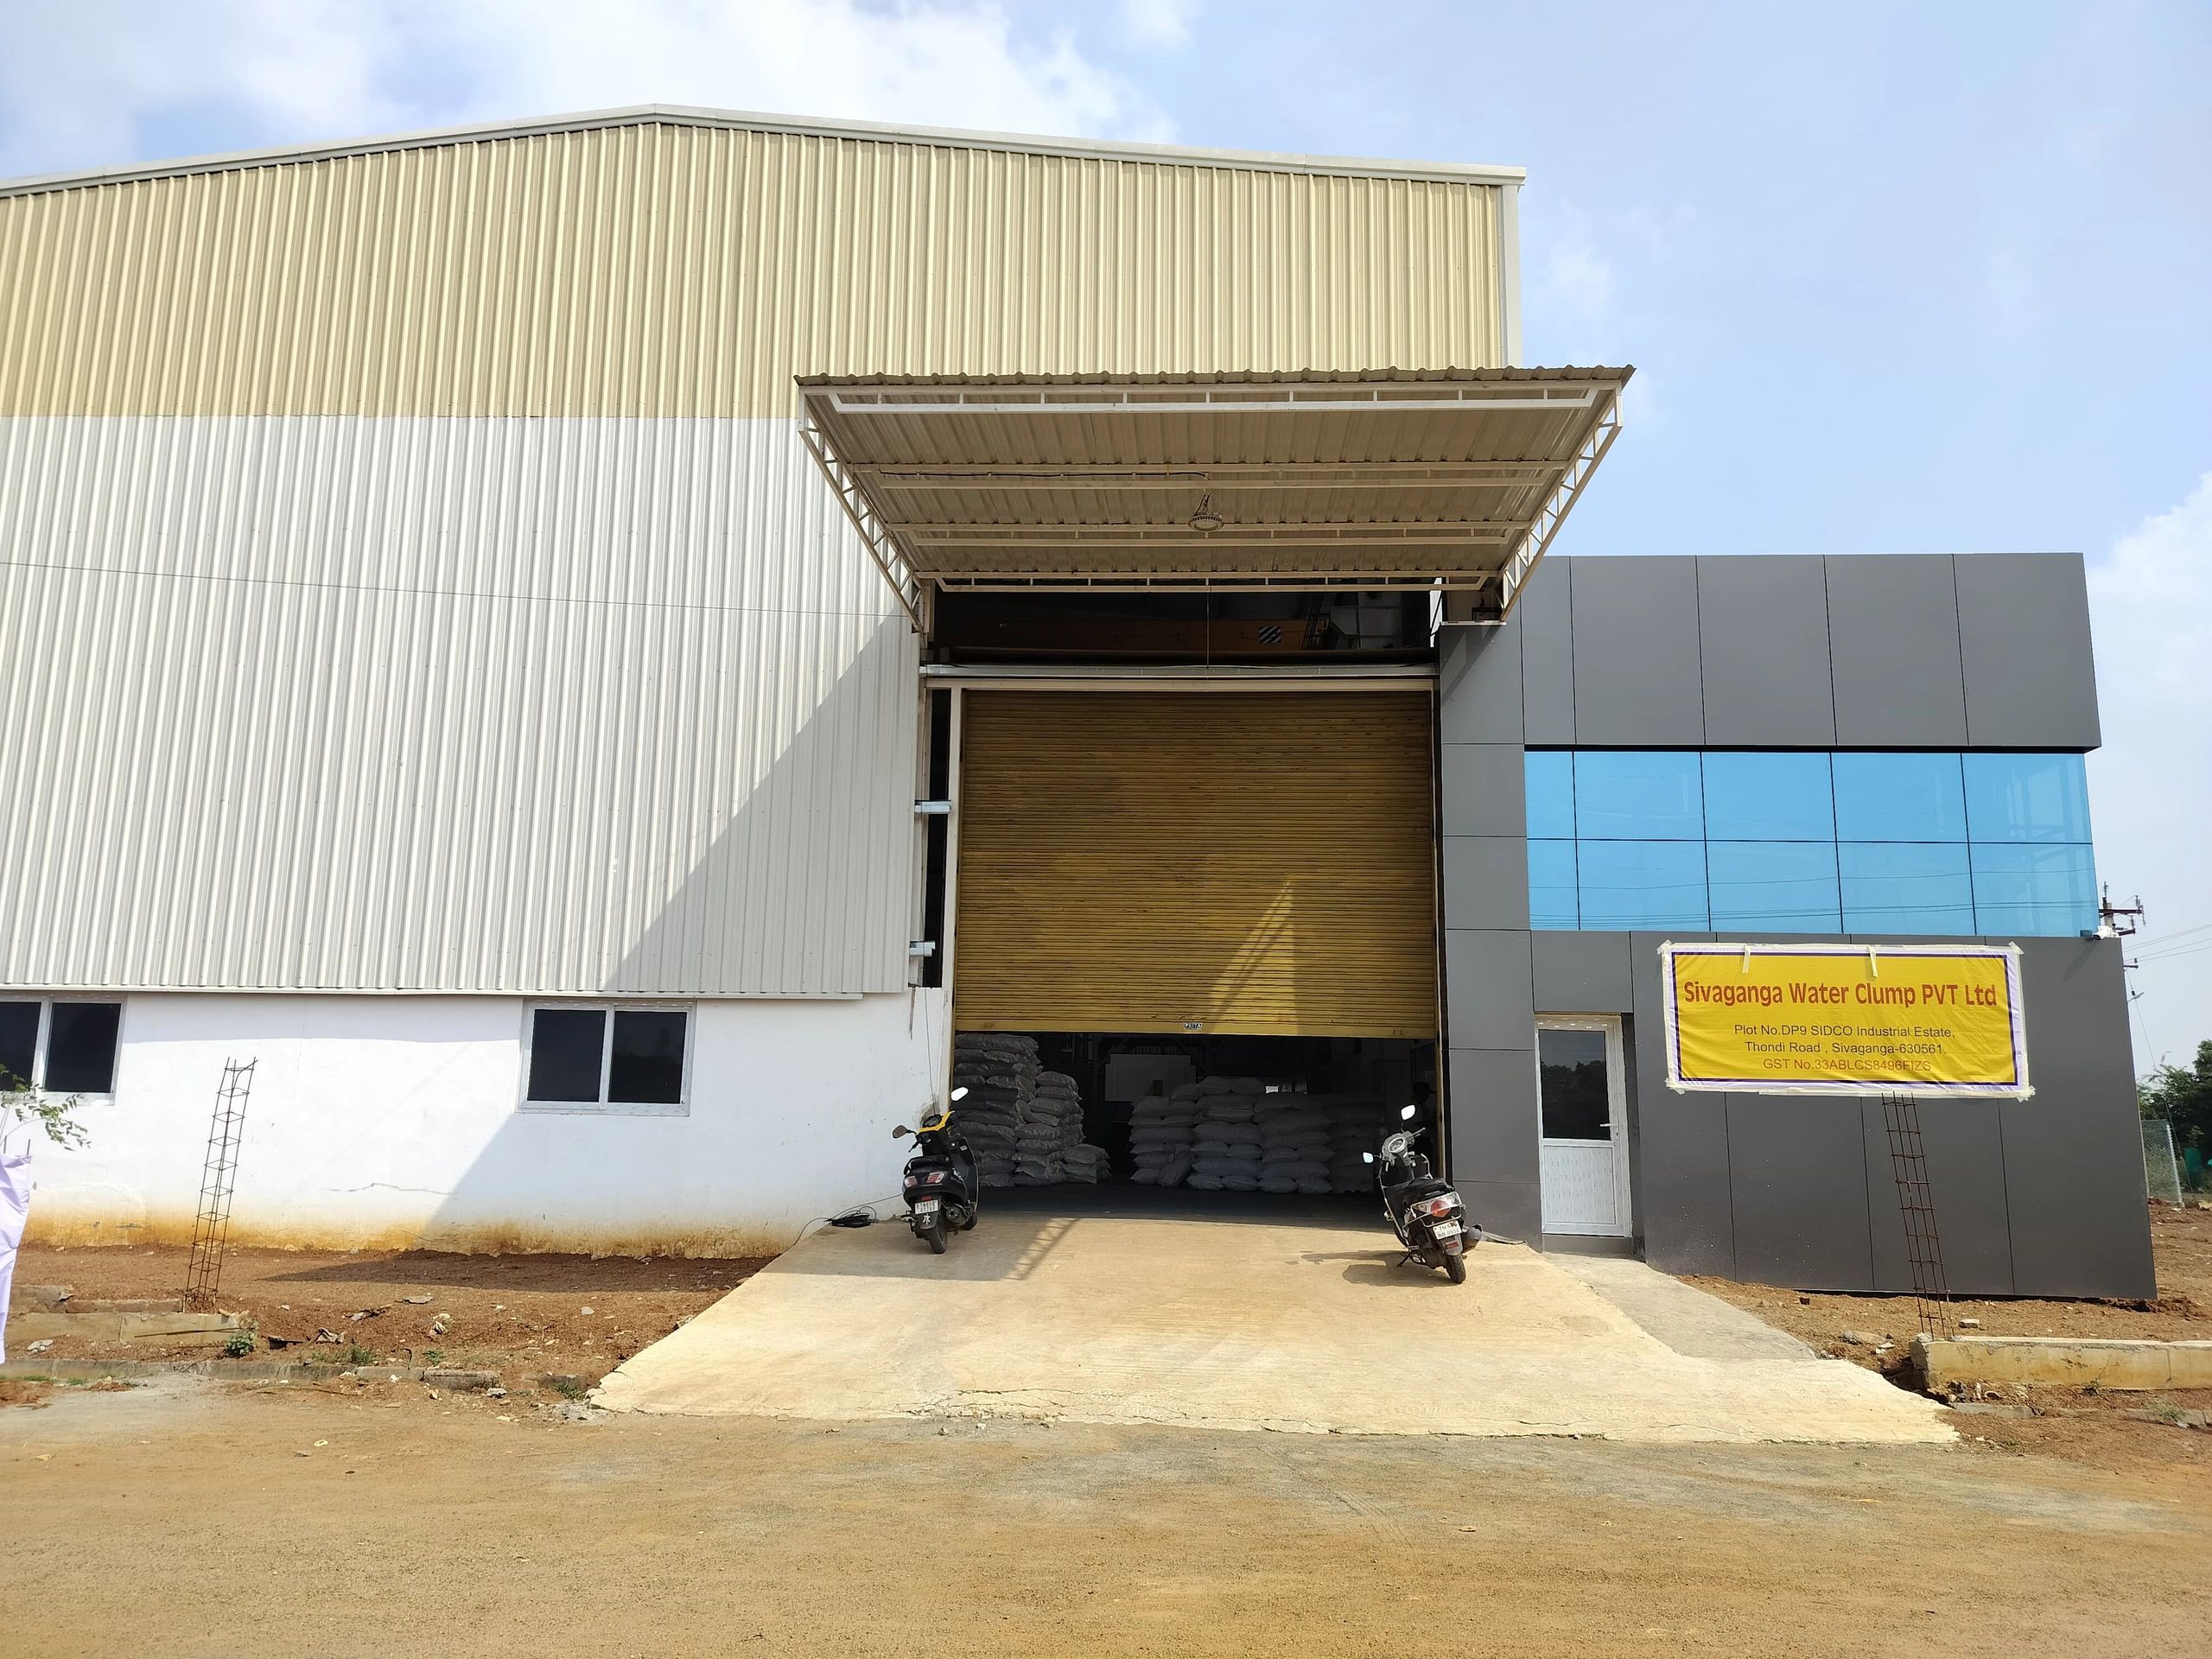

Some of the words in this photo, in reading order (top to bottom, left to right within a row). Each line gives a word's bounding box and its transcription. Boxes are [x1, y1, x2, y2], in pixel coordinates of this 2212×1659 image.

[1684, 982, 1783, 1006] Sivaganga
[1789, 982, 1849, 1004] Water
[1855, 983, 1916, 1007] Clump
[1922, 984, 1958, 1005] PVT
[1965, 984, 1997, 1006] Ltd
[1734, 1025, 1758, 1035] Plot
[1761, 1025, 1807, 1035] No.DP9
[1811, 1026, 1853, 1036] SIDCO
[1857, 1027, 1910, 1037] Industrial
[1914, 1027, 1955, 1039] Estate,
[1745, 1042, 1785, 1052] Thondi
[1789, 1042, 1821, 1052] Road
[1832, 1043, 1947, 1055] Sivaganga-630561.
[1763, 1059, 1789, 1069] GST
